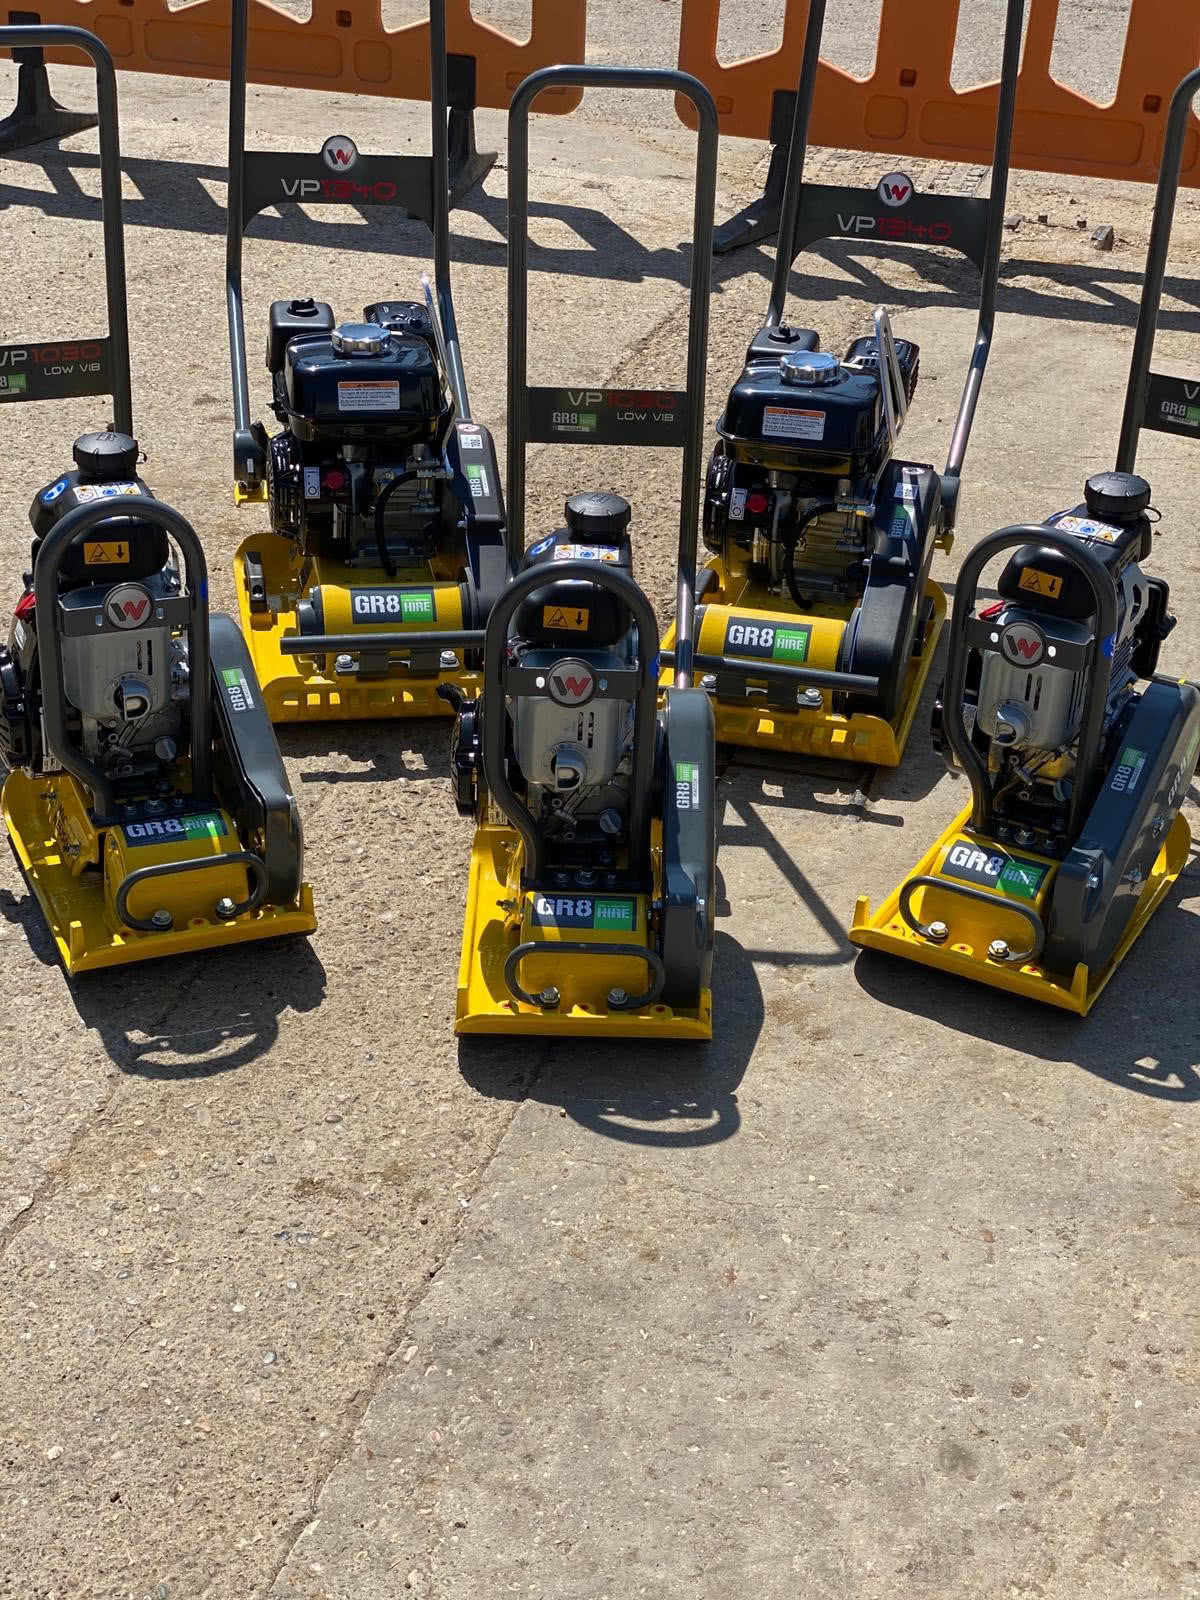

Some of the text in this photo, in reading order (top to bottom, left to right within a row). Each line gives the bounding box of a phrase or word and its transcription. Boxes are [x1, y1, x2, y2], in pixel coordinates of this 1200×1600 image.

[44, 362, 101, 376] LOW VIB
[552, 412, 578, 424] GR8
[617, 412, 674, 422] LOW VIB
[1161, 401, 1186, 416] GR8
[354, 595, 430, 614] GR8 HIRE
[728, 624, 803, 651] GR8 HIRE
[228, 686, 246, 711] GR8
[1111, 765, 1132, 792] GR8
[676, 782, 690, 809] GR8
[126, 818, 182, 838] GR8
[949, 846, 1001, 876] GR8
[536, 898, 631, 919] GR8 HIRE
